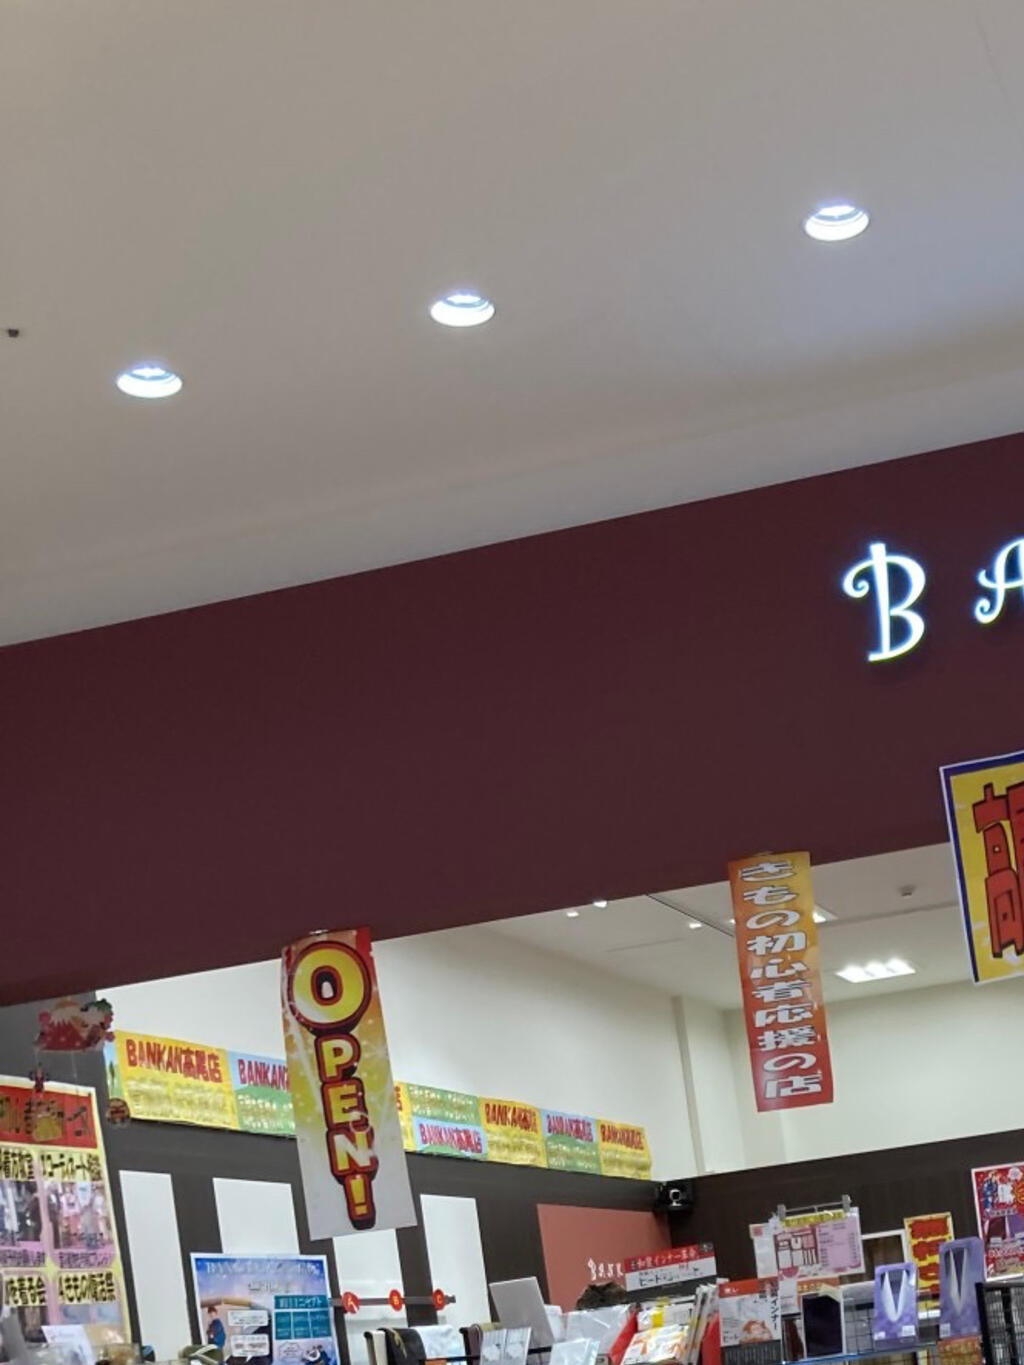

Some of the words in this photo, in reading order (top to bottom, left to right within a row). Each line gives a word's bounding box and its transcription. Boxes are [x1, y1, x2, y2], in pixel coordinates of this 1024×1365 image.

[125, 1038, 223, 1083] BANKAN高尾店
[286, 940, 379, 1231] OPEN!
[738, 860, 823, 1099] きもの初心者応援の店
